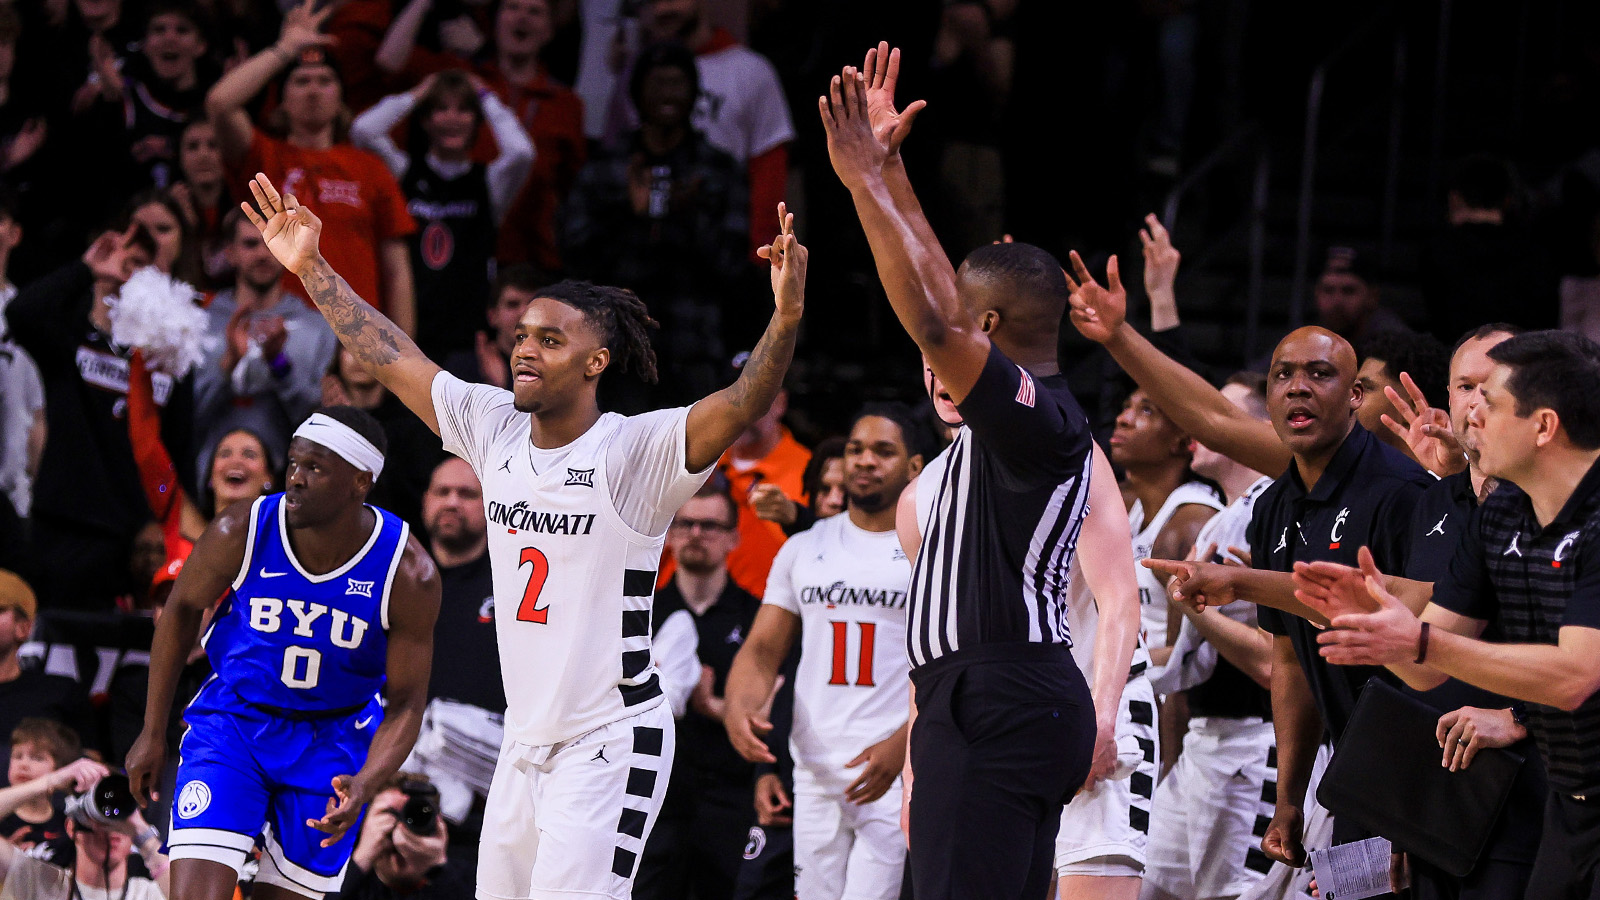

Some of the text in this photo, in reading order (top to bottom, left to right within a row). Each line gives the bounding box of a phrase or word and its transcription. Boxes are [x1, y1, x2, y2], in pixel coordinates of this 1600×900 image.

[488, 501, 597, 535] CINCINNATI
[516, 547, 550, 625] 2
[801, 582, 907, 610] CINCINNATI
[249, 597, 369, 650] BYU
[280, 645, 321, 690] 0
[828, 620, 876, 688] 11
